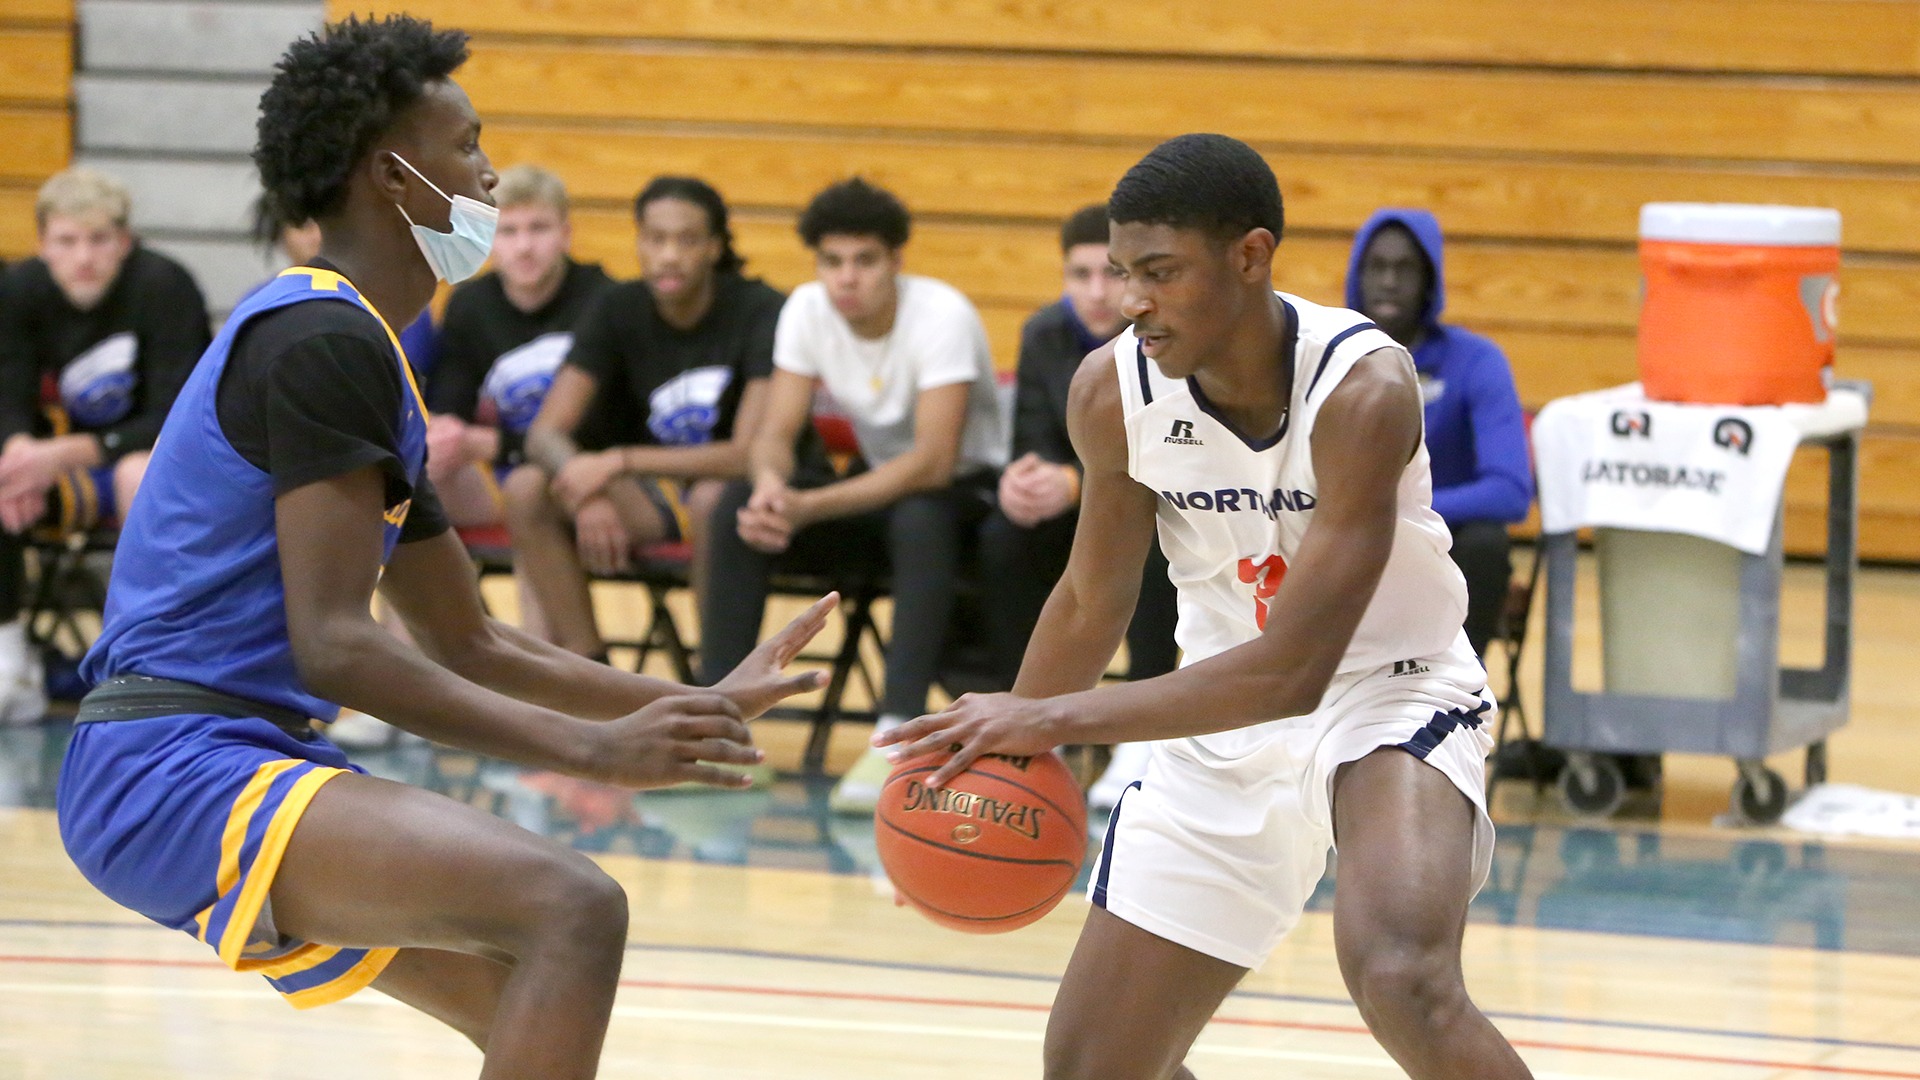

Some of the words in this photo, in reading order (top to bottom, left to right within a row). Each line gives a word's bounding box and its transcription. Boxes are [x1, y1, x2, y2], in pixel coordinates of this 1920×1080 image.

[1163, 436, 1204, 446] RUSSELL
[1170, 420, 1193, 438] R
[1161, 488, 1317, 520] NORTND
[904, 781, 1046, 839] SPALDING
